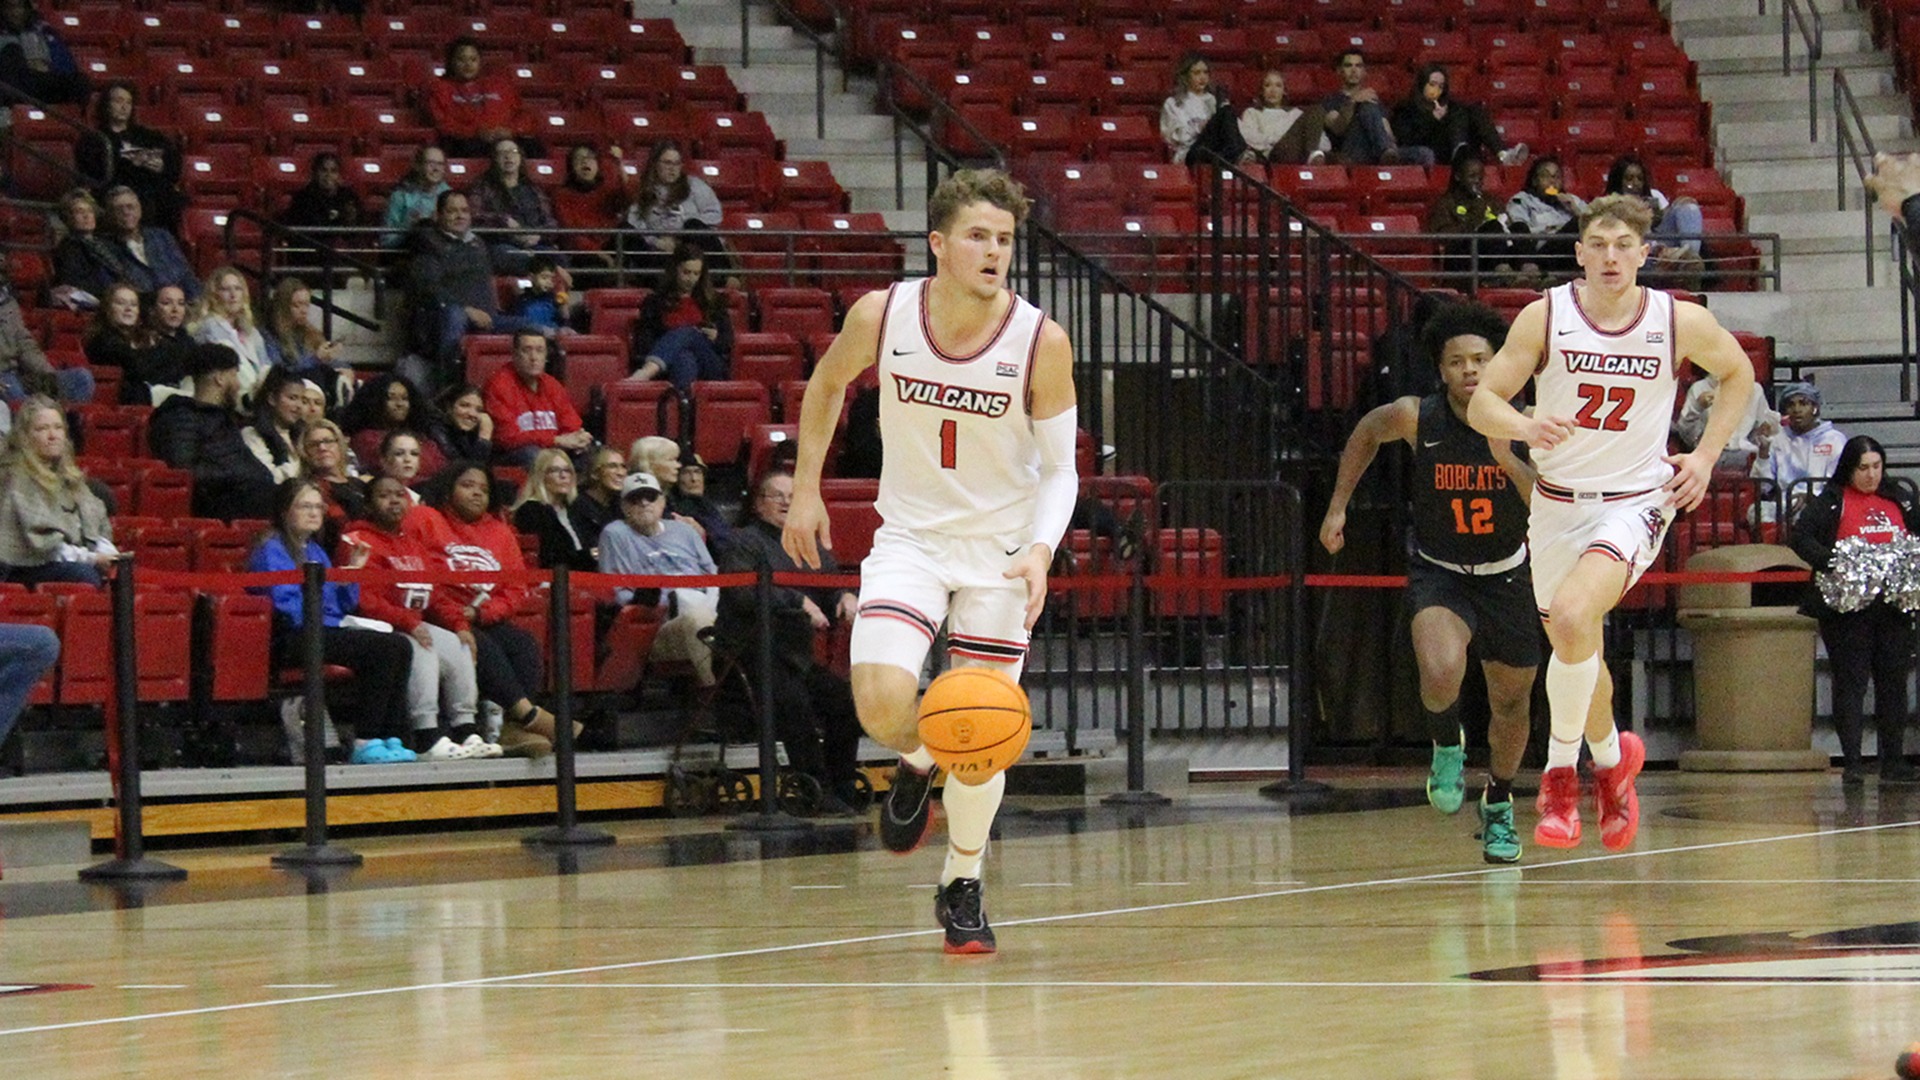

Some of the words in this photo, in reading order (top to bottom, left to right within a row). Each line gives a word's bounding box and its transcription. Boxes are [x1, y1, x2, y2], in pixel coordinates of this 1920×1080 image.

[1563, 351, 1659, 378] VULCANS
[894, 375, 1010, 417] VULCANS
[1575, 383, 1635, 432] 22
[939, 419, 957, 469] 1
[1435, 463, 1506, 491] BOBCATS
[1451, 498, 1495, 534] 12
